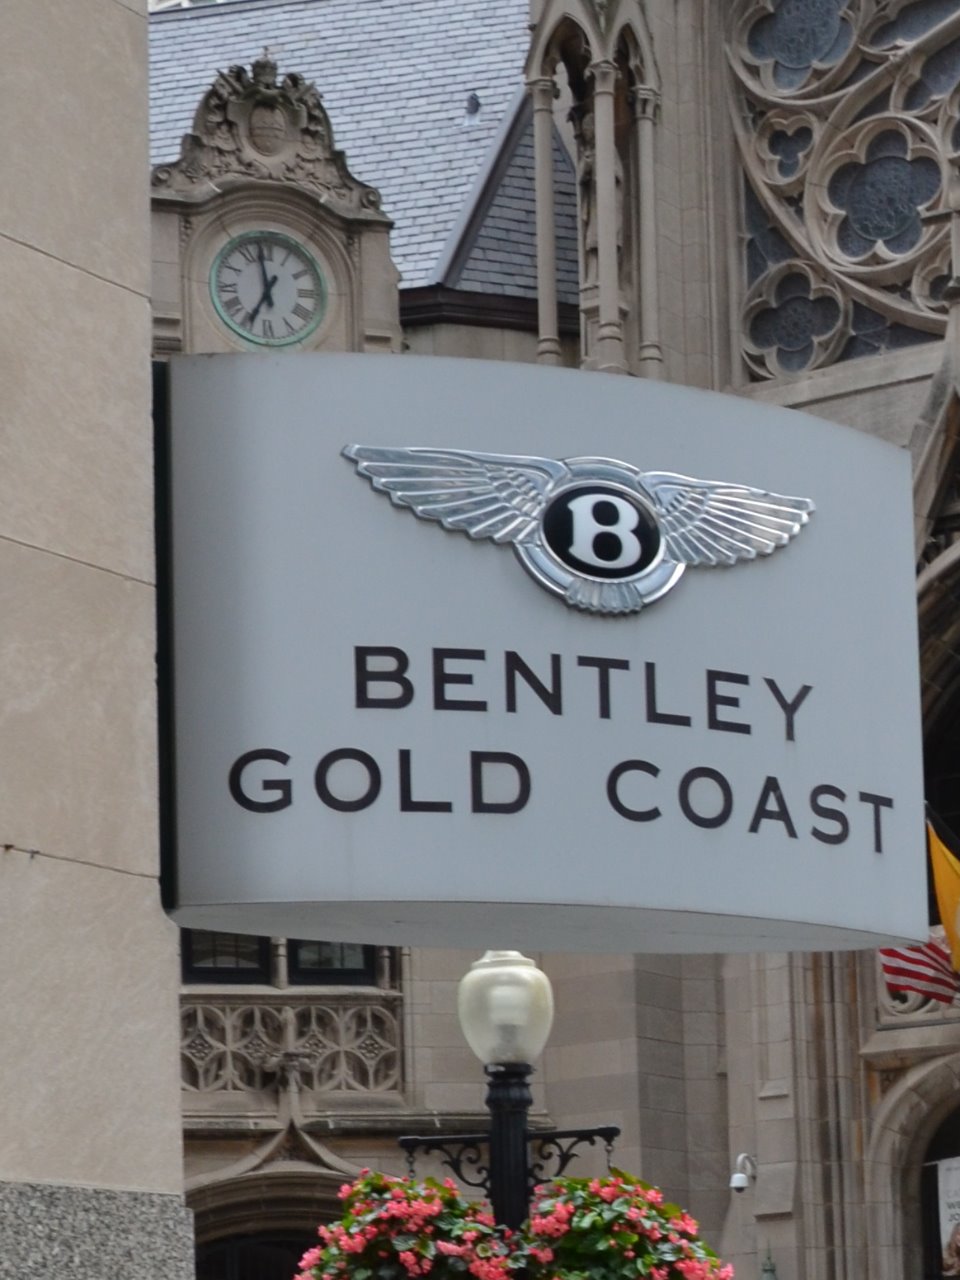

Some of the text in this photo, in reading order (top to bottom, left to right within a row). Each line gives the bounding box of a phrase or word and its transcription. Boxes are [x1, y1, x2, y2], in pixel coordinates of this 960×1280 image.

[567, 493, 641, 570] B
[354, 645, 813, 741] BENTLEY
[227, 747, 895, 854] GOLD COAST
